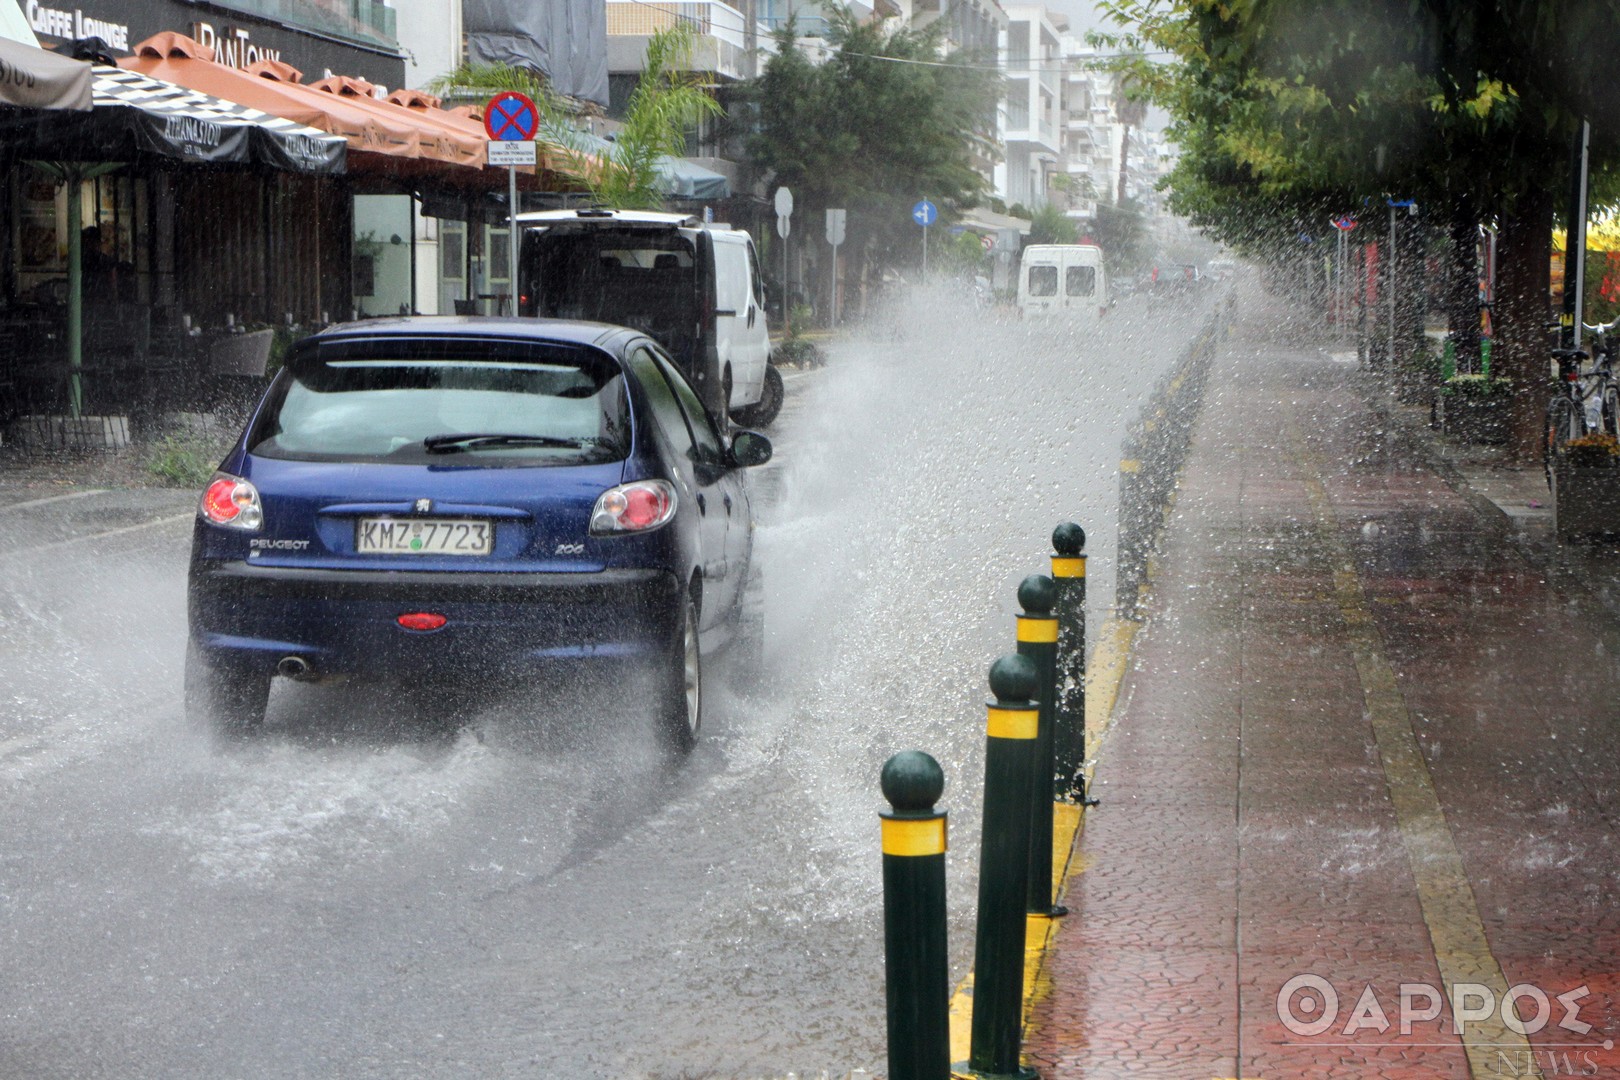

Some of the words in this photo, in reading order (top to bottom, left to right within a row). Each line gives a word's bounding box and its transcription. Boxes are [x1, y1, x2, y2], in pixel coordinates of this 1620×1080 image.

[26, 0, 73, 39] CAFFE
[75, 9, 128, 51] LOUNGE
[164, 116, 222, 147] ATHANASIOU
[250, 539, 309, 550] PEUGEOT
[363, 522, 410, 549] KMZ
[424, 523, 486, 549] 7723
[555, 544, 584, 554] 206
